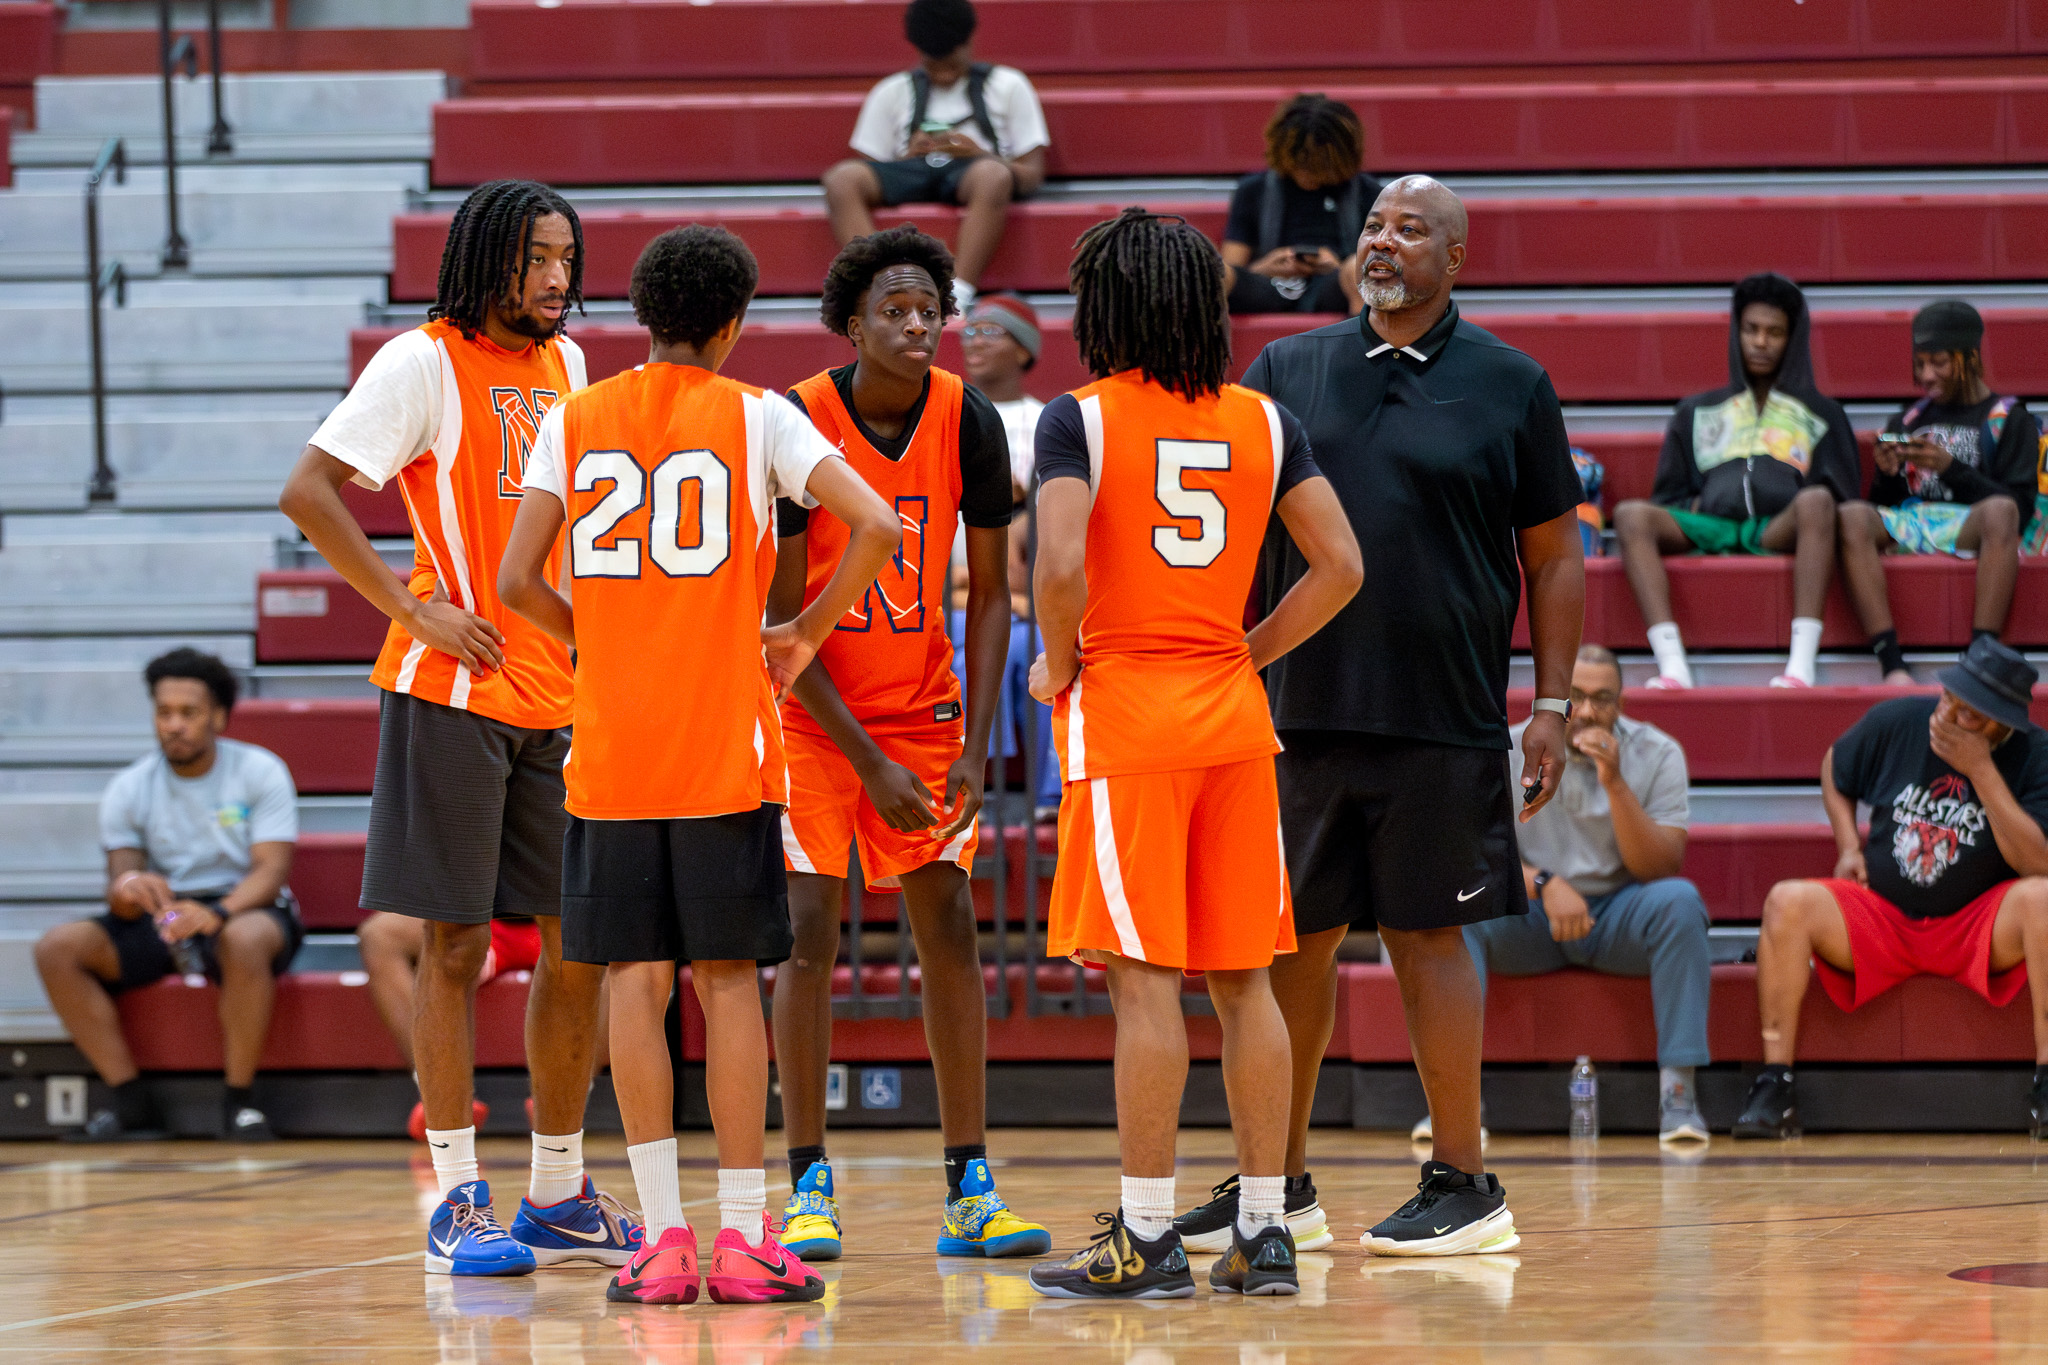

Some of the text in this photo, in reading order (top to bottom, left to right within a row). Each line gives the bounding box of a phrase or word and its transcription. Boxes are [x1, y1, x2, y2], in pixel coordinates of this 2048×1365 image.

[489, 387, 558, 499] N
[1151, 438, 1231, 568] 5
[571, 449, 731, 579] 20
[835, 496, 928, 633] N
[1893, 783, 1931, 815] ALL
